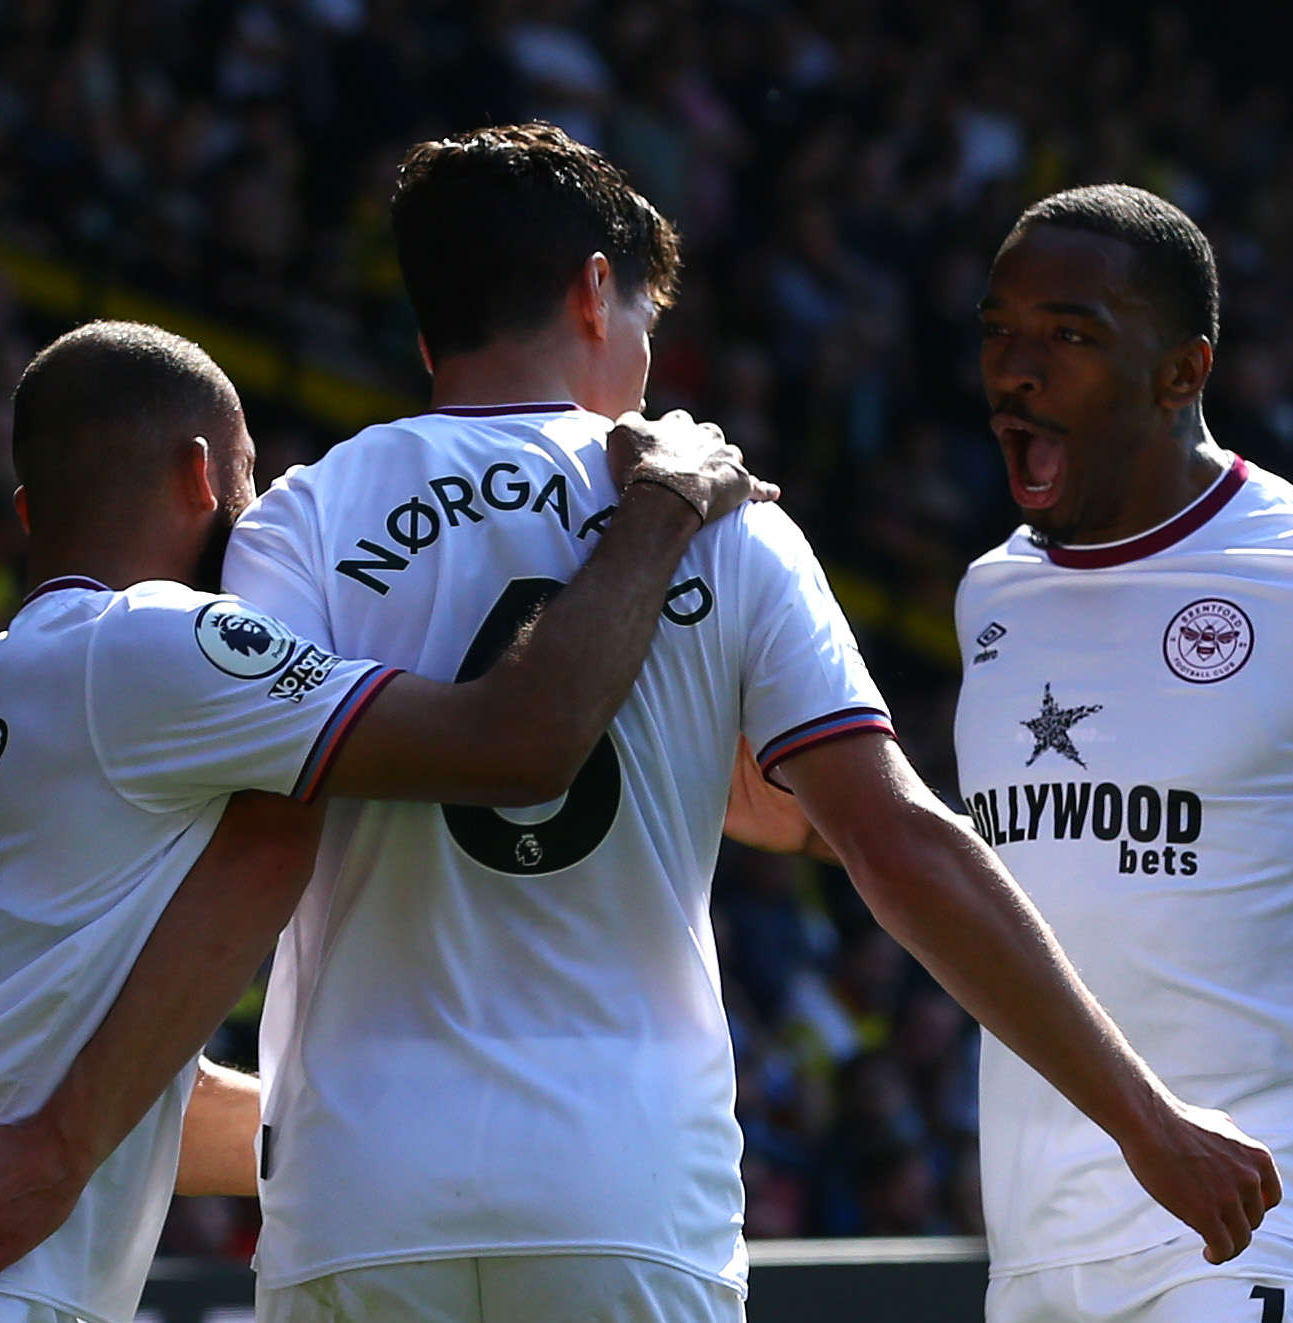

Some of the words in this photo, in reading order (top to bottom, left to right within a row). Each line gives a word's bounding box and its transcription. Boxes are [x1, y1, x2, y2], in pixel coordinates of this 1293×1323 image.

[335, 462, 714, 627] NØRGAD
[1181, 604, 1242, 627] BRENTFORD
[1174, 657, 1210, 677] FOOTBALL
[1213, 661, 1235, 676] CLUB
[1119, 840, 1198, 876] bets
